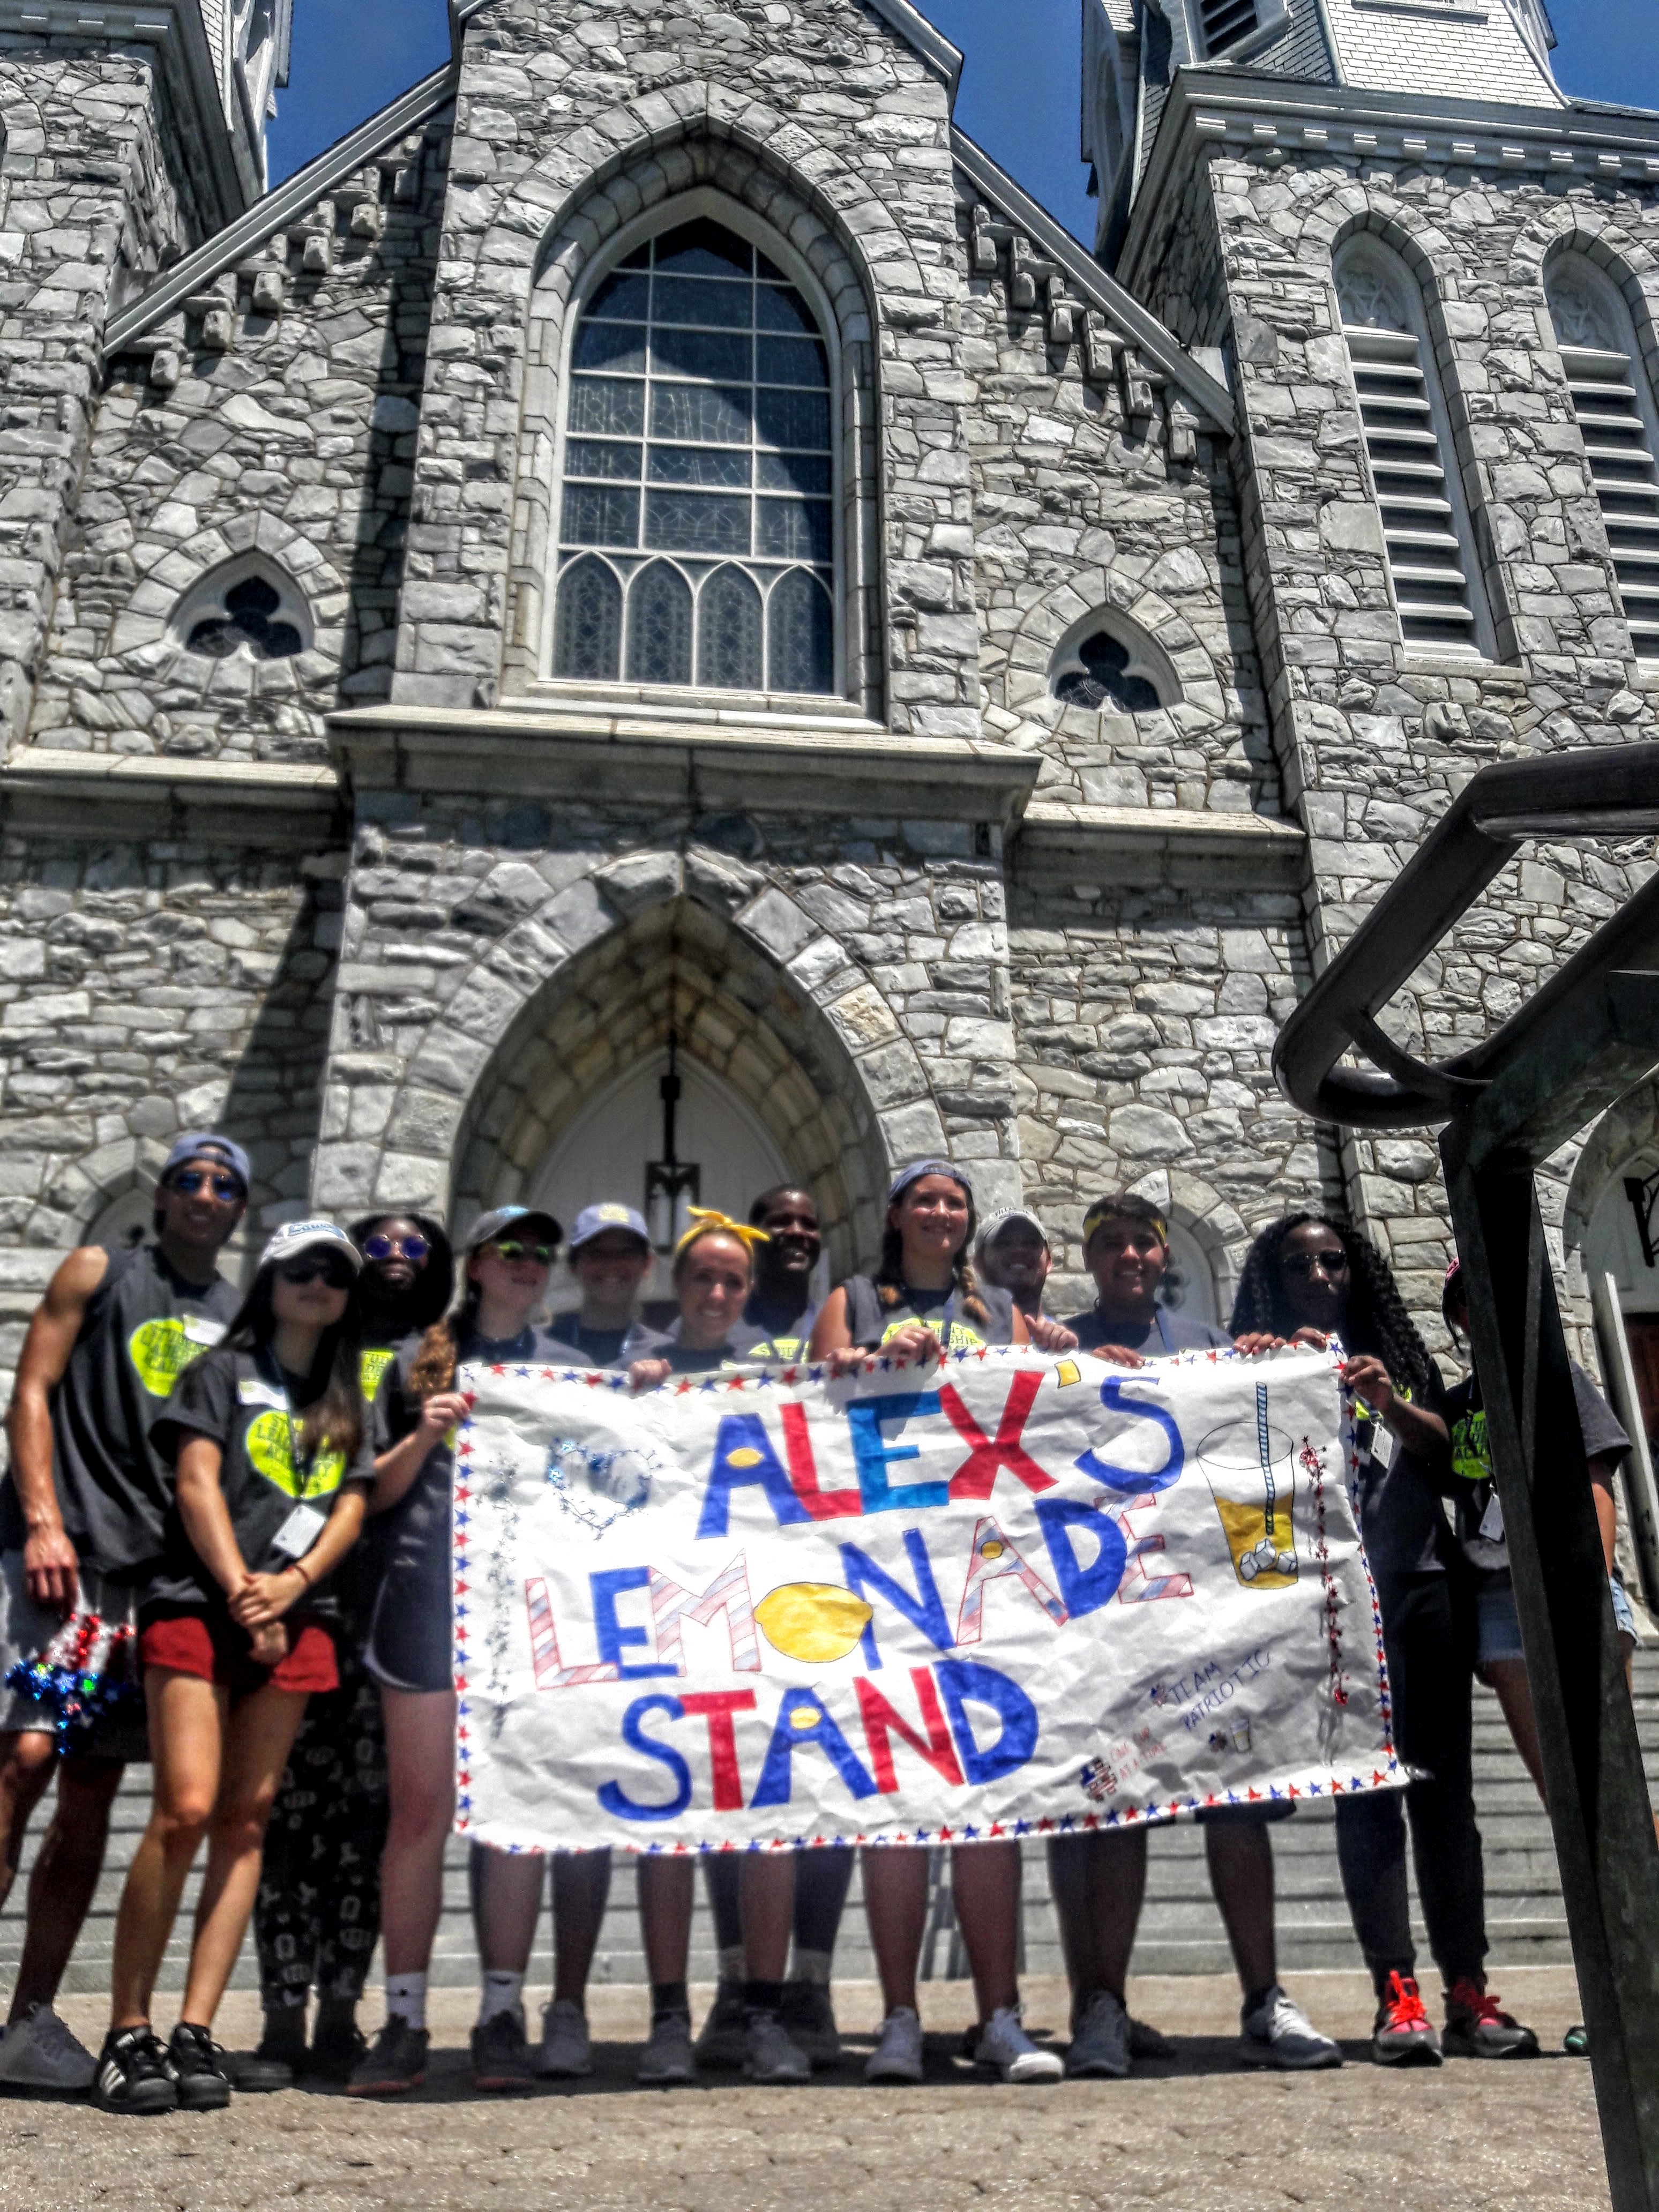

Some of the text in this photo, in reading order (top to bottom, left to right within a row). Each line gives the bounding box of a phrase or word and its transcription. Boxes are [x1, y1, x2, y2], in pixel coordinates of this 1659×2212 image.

[694, 1359, 1185, 1540] ALEX'S
[525, 1492, 1194, 1691] LEMONADE
[597, 1658, 1039, 1821] STAND
[1169, 1661, 1221, 1705] TEAM
[1180, 1649, 1270, 1731] PATRIOTIC
